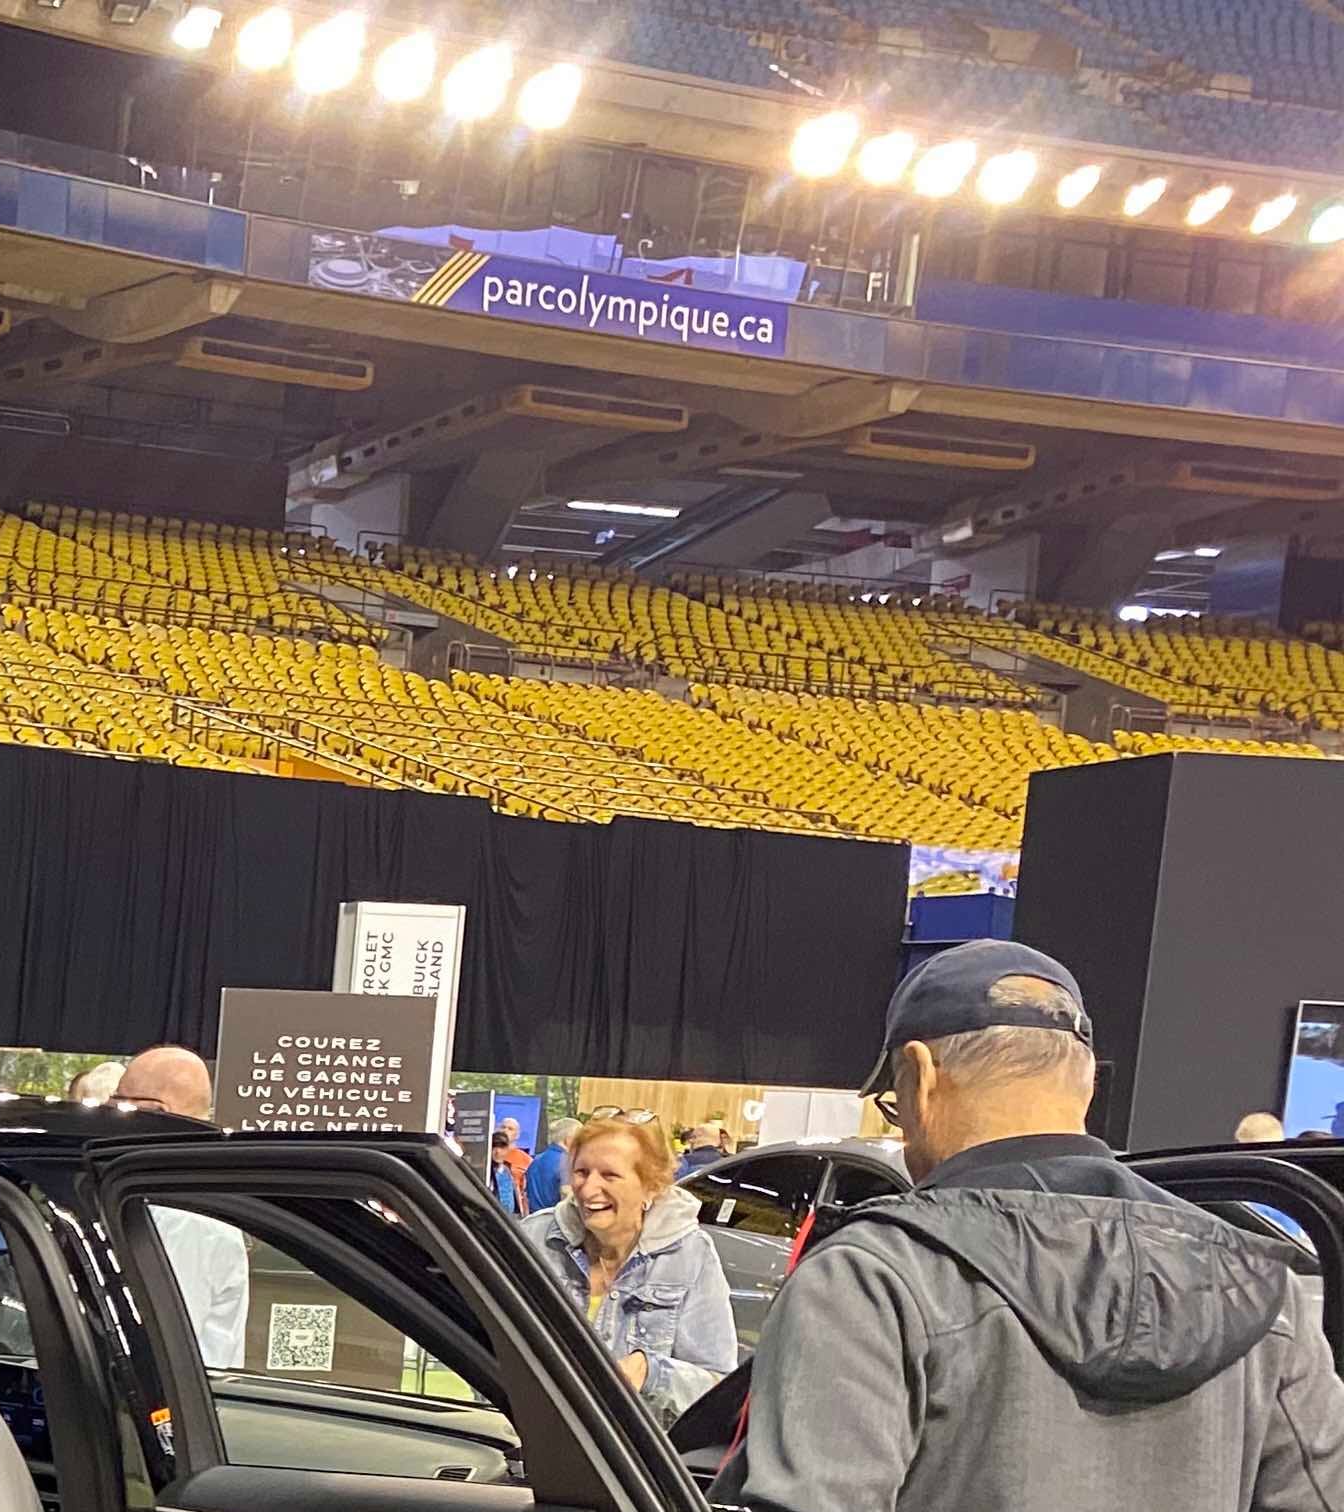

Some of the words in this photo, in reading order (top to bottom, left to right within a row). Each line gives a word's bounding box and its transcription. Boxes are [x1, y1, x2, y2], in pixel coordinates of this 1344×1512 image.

[482, 274, 774, 345] parcolympique.ca
[380, 931, 394, 972] GMC
[413, 939, 429, 995] BUICK
[277, 1035, 382, 1051] COUREZ
[253, 1051, 286, 1065] LA
[297, 1053, 403, 1069] CHANCE
[252, 1069, 285, 1082] DE
[296, 1070, 402, 1086] GAGNER
[237, 1085, 272, 1098] UN
[283, 1085, 413, 1103] VÉHICULE
[259, 1103, 389, 1118] CADILLAC
